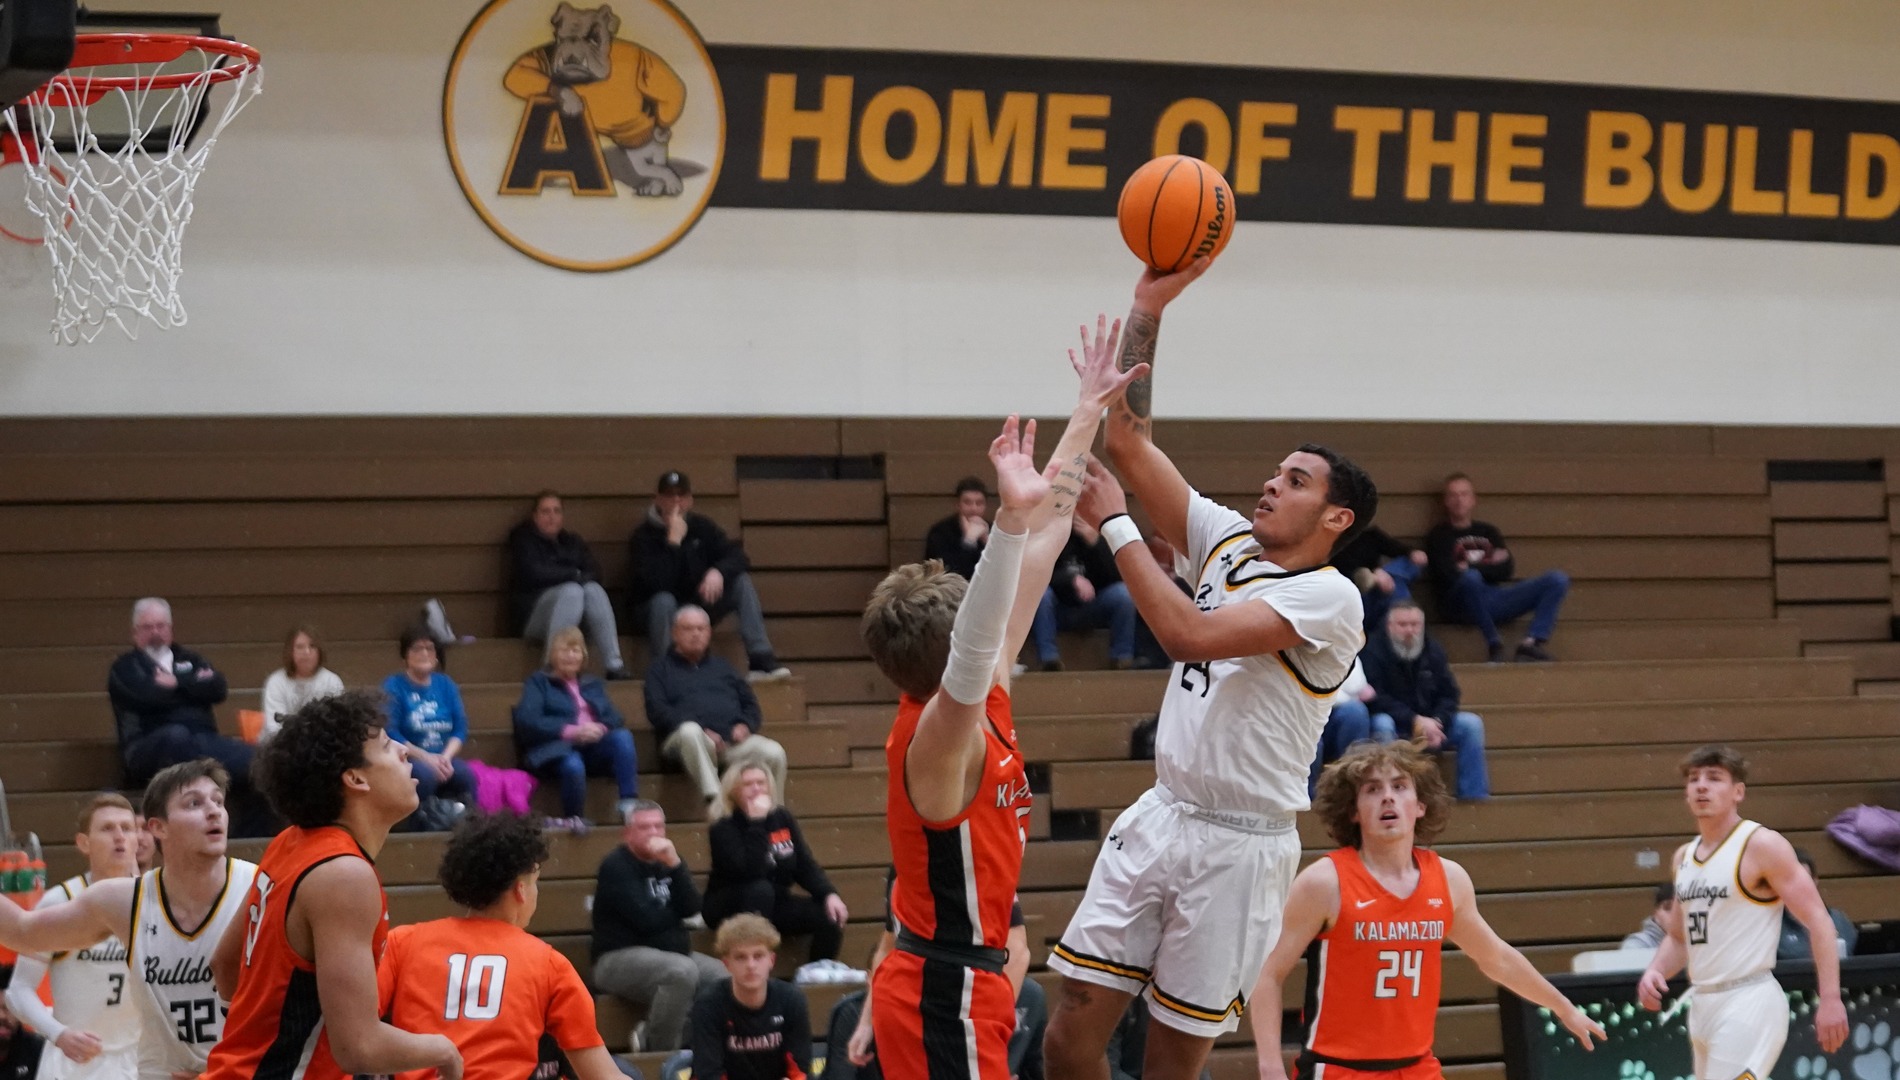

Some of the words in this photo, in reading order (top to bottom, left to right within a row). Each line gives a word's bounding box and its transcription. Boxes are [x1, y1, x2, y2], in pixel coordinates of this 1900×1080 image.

[497, 94, 618, 198] A
[759, 72, 1111, 190] HOME
[1152, 96, 1298, 194] OF
[1334, 105, 1548, 205] THE
[1584, 110, 1900, 220] BULLD
[1192, 185, 1226, 260] Wilson
[1354, 920, 1445, 941] KALAMAZOO
[1688, 911, 1708, 945] 20
[106, 973, 125, 1006] 3
[143, 955, 218, 993] Bulldo
[444, 953, 509, 1021] 10
[1374, 949, 1423, 998] 24
[169, 997, 218, 1044] 32
